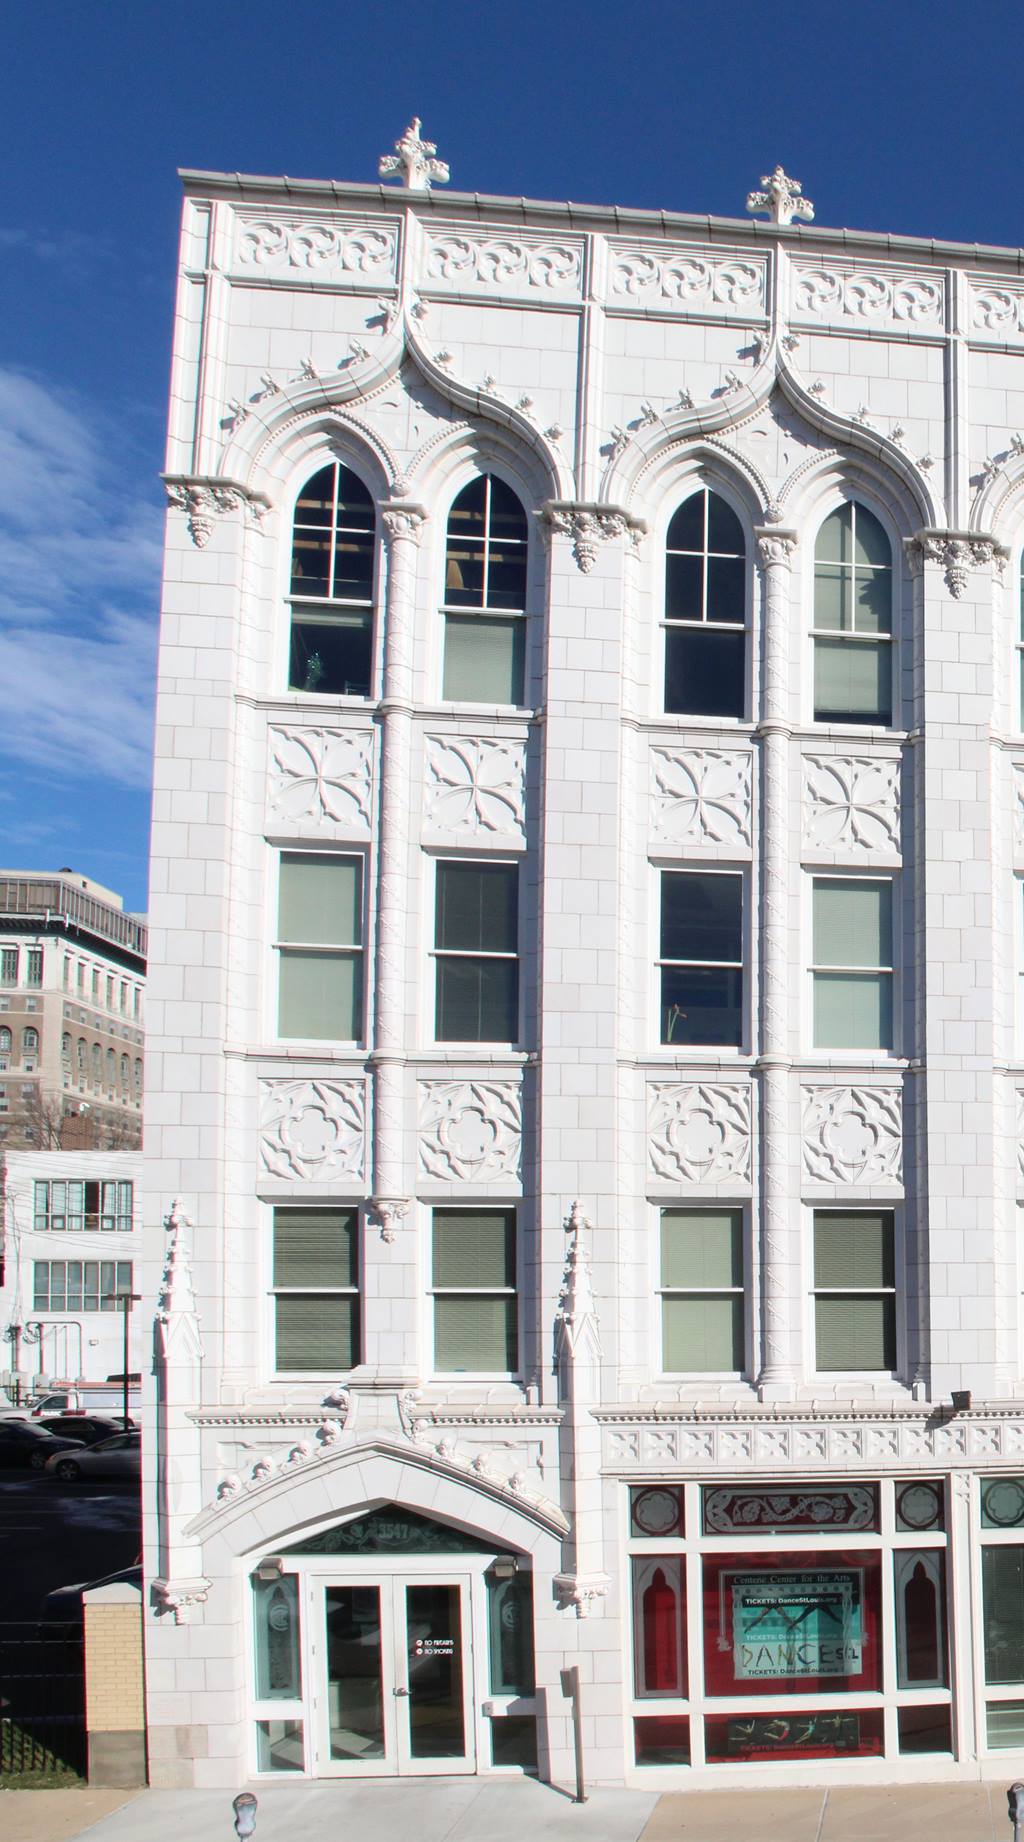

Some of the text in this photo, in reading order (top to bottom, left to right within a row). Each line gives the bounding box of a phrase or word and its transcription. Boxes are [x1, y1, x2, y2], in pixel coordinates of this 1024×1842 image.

[378, 1523, 409, 1539] 3547
[733, 1573, 851, 1585] Centene Center for the Arts
[742, 1644, 834, 1667] DANCE
